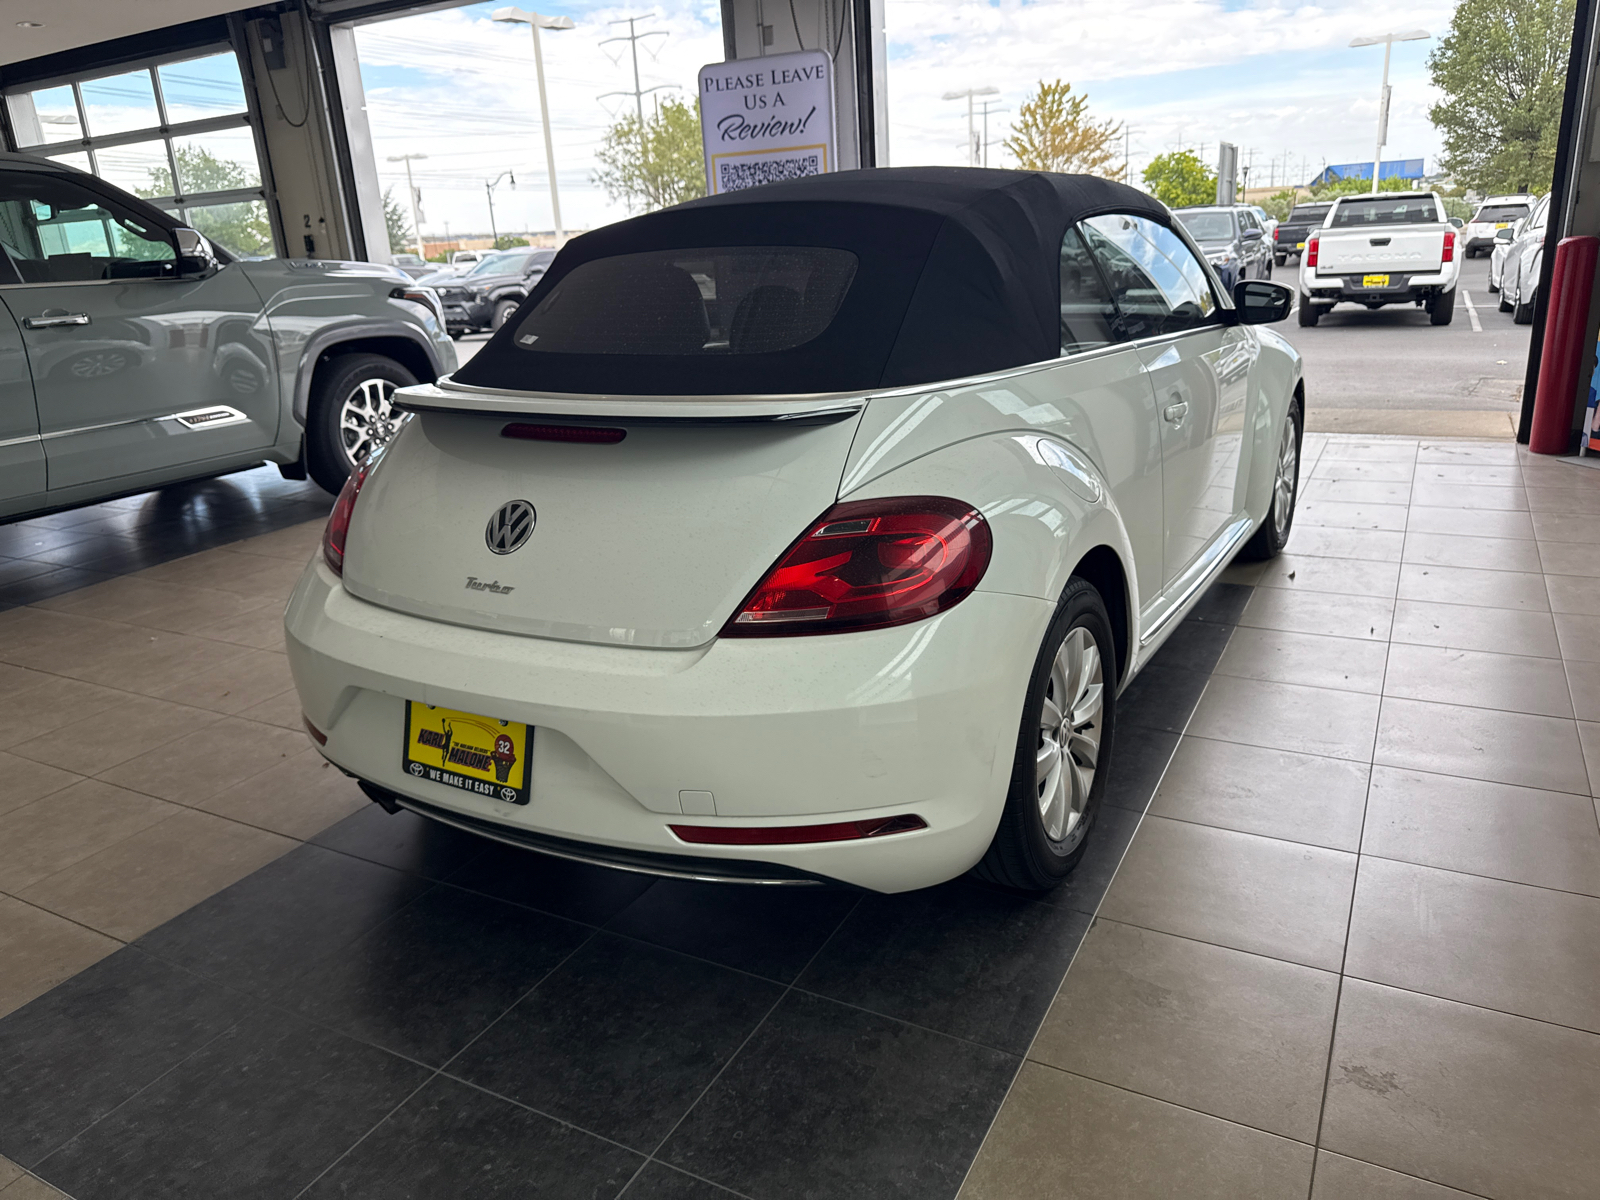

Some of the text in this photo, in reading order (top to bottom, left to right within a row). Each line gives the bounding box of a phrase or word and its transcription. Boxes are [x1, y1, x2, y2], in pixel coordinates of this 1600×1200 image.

[704, 64, 825, 93] PLEASE LEAVE
[743, 92, 786, 111] US A
[716, 106, 817, 142] Review!
[303, 214, 312, 228] 2
[1338, 252, 1422, 262] TACOMA
[465, 576, 515, 595] Turbo
[417, 728, 446, 750] KARL
[498, 740, 510, 754] 32
[448, 747, 492, 772] MALONE
[429, 769, 494, 795] WE MAKE IT EASY
